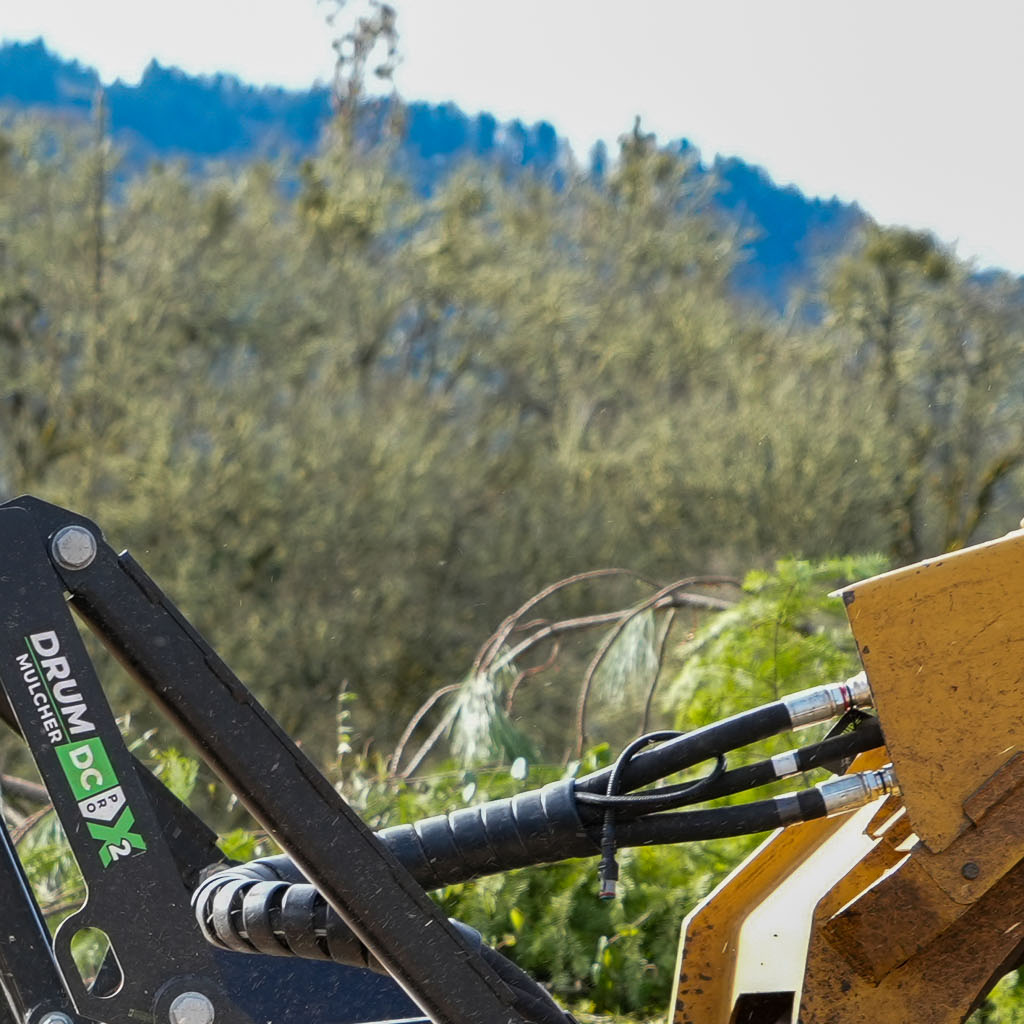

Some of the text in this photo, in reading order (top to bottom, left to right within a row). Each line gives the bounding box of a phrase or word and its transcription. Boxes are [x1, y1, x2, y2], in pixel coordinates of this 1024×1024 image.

[15, 653, 63, 744] MULCHER
[29, 630, 96, 735] DRUM
[68, 744, 104, 792] DC
[86, 793, 119, 813] PRO
